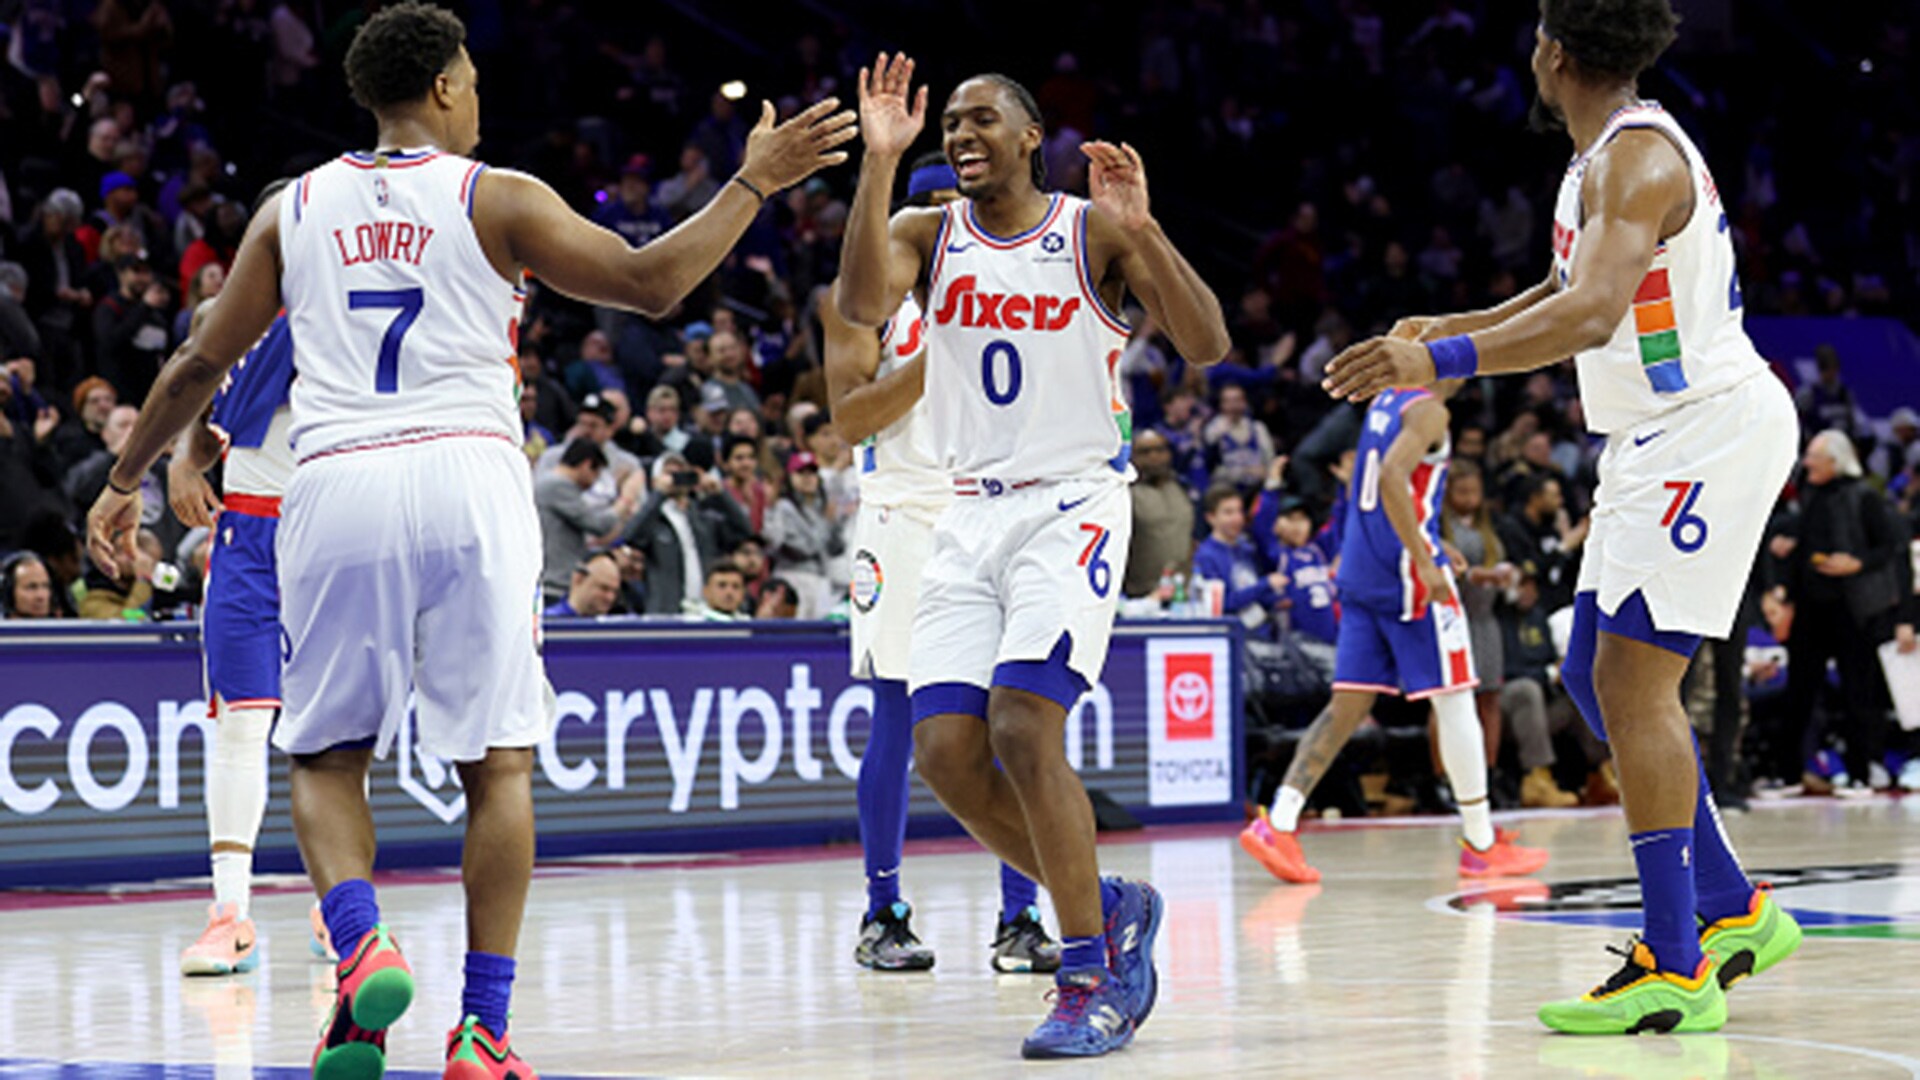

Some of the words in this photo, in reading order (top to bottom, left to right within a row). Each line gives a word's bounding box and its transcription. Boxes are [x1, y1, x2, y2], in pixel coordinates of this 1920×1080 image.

[333, 221, 435, 267] LOWRY
[934, 274, 1081, 332] Sixers
[348, 286, 424, 394] 7
[981, 338, 1023, 407] 0
[1660, 480, 1708, 554] 76
[1077, 522, 1112, 599] 76
[1155, 757, 1226, 784] TOYOTA
